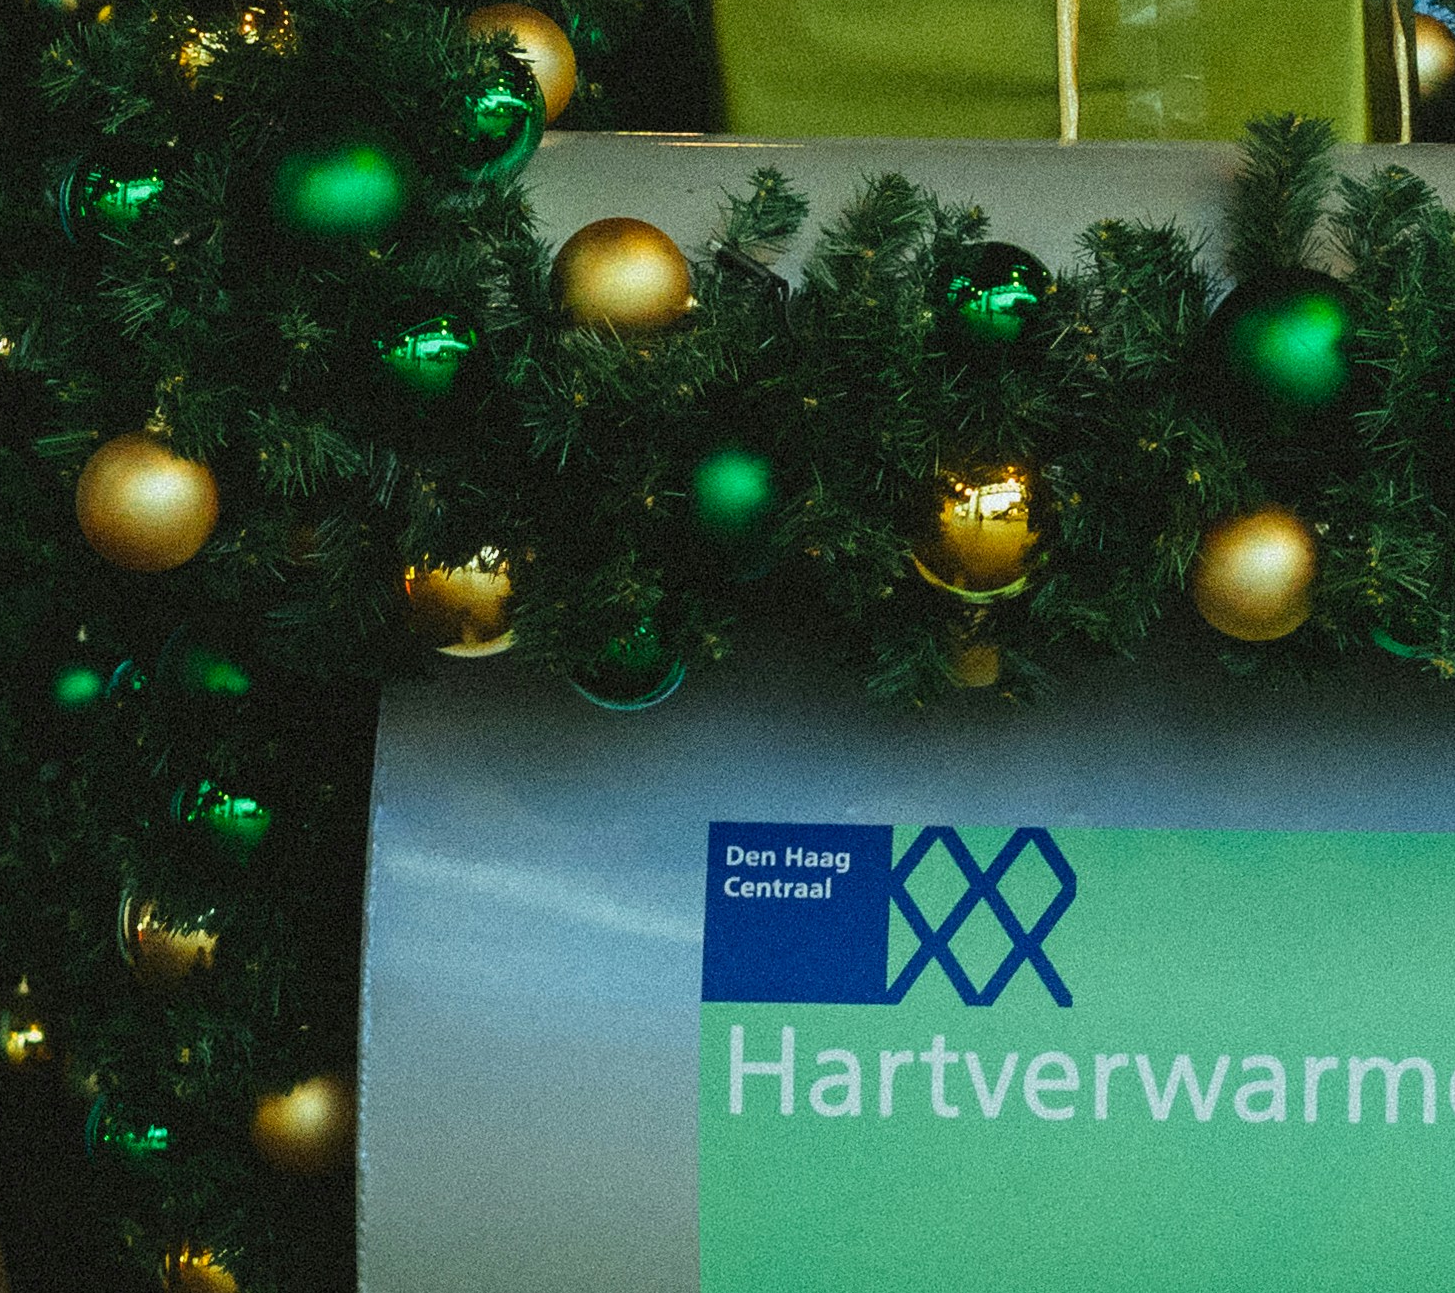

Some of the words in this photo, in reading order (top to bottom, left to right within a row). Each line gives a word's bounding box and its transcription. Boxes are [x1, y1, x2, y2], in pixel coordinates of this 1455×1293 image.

[724, 844, 777, 868] Den
[784, 845, 851, 874] Haag
[723, 876, 832, 900] Centraal
